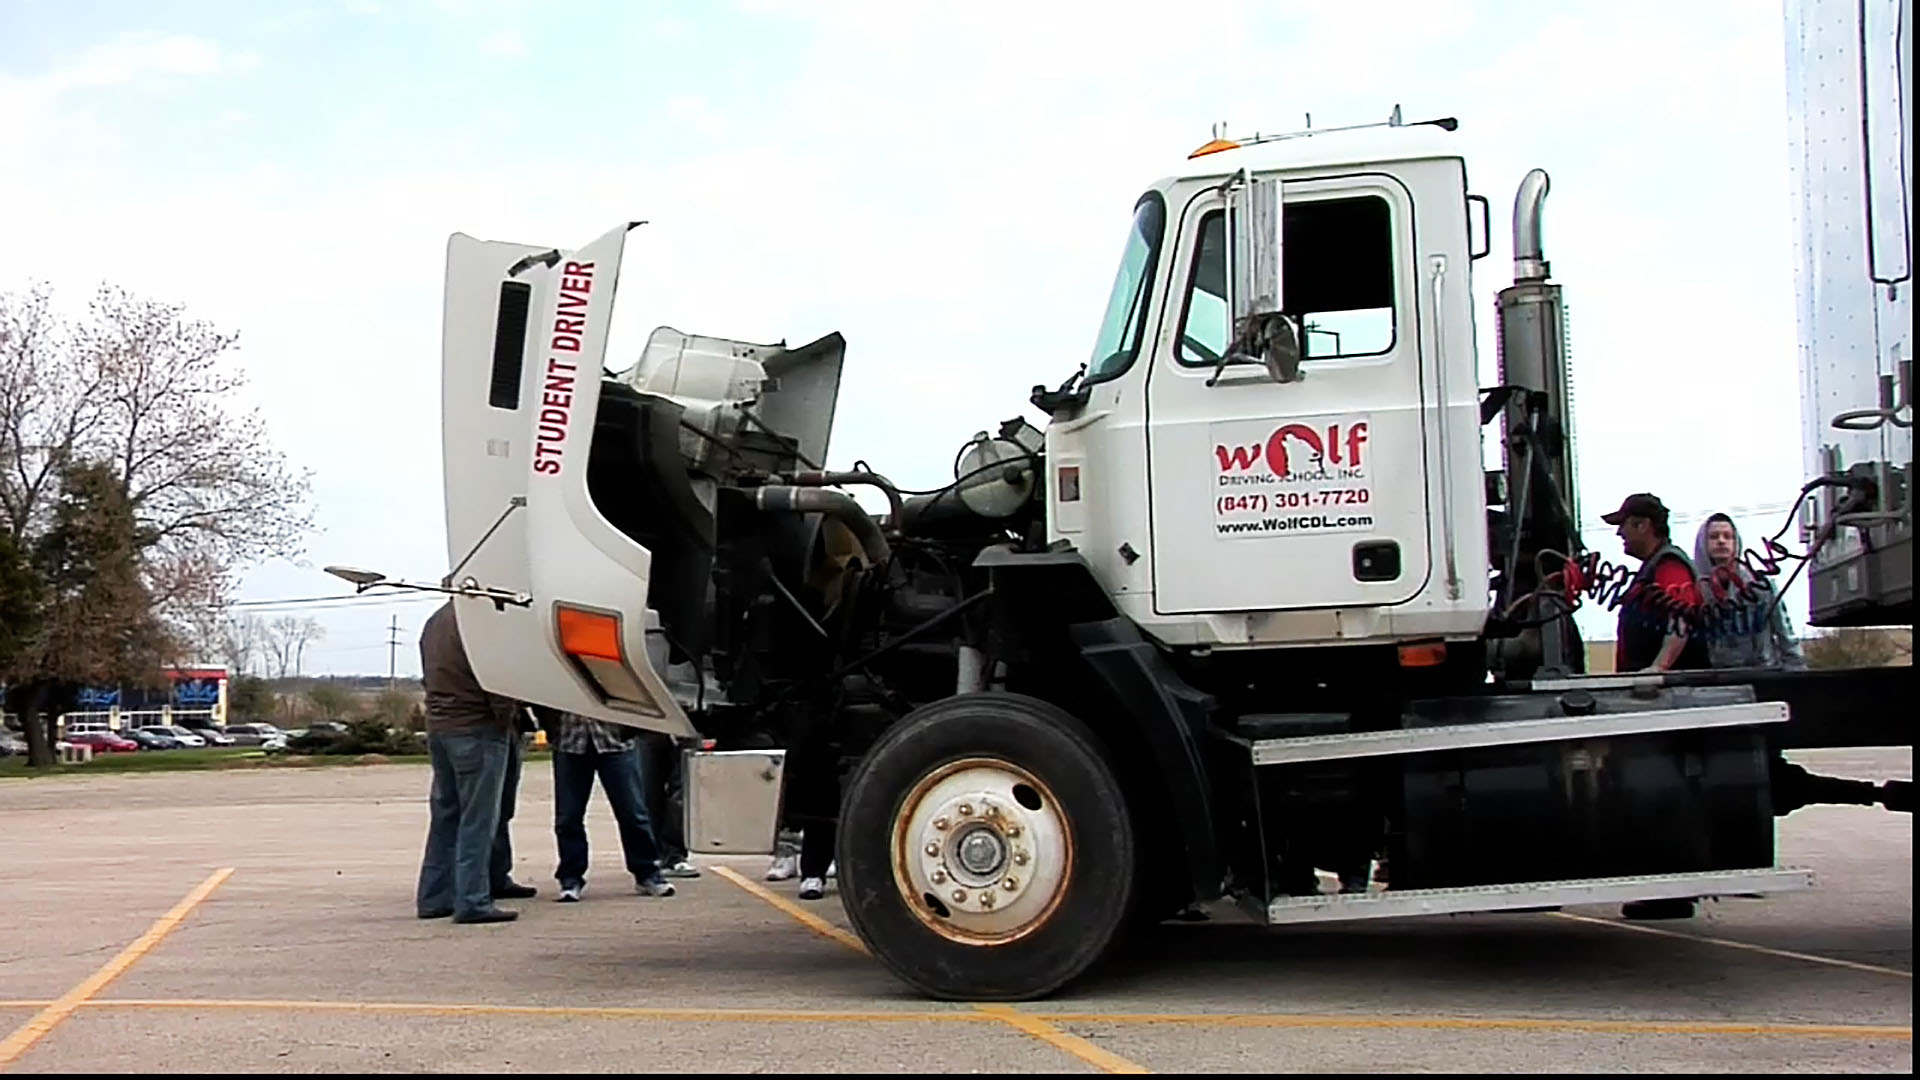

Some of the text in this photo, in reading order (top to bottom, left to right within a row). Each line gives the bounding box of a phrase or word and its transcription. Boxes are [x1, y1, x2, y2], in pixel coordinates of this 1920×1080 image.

[534, 261, 595, 475] STUDENT DRIVER
[1219, 474, 1275, 486] DRIVING
[1279, 470, 1334, 483] CHOOL
[1216, 488, 1370, 515] (847) 301-7720
[1216, 515, 1374, 533] www.WolfCDL.com
